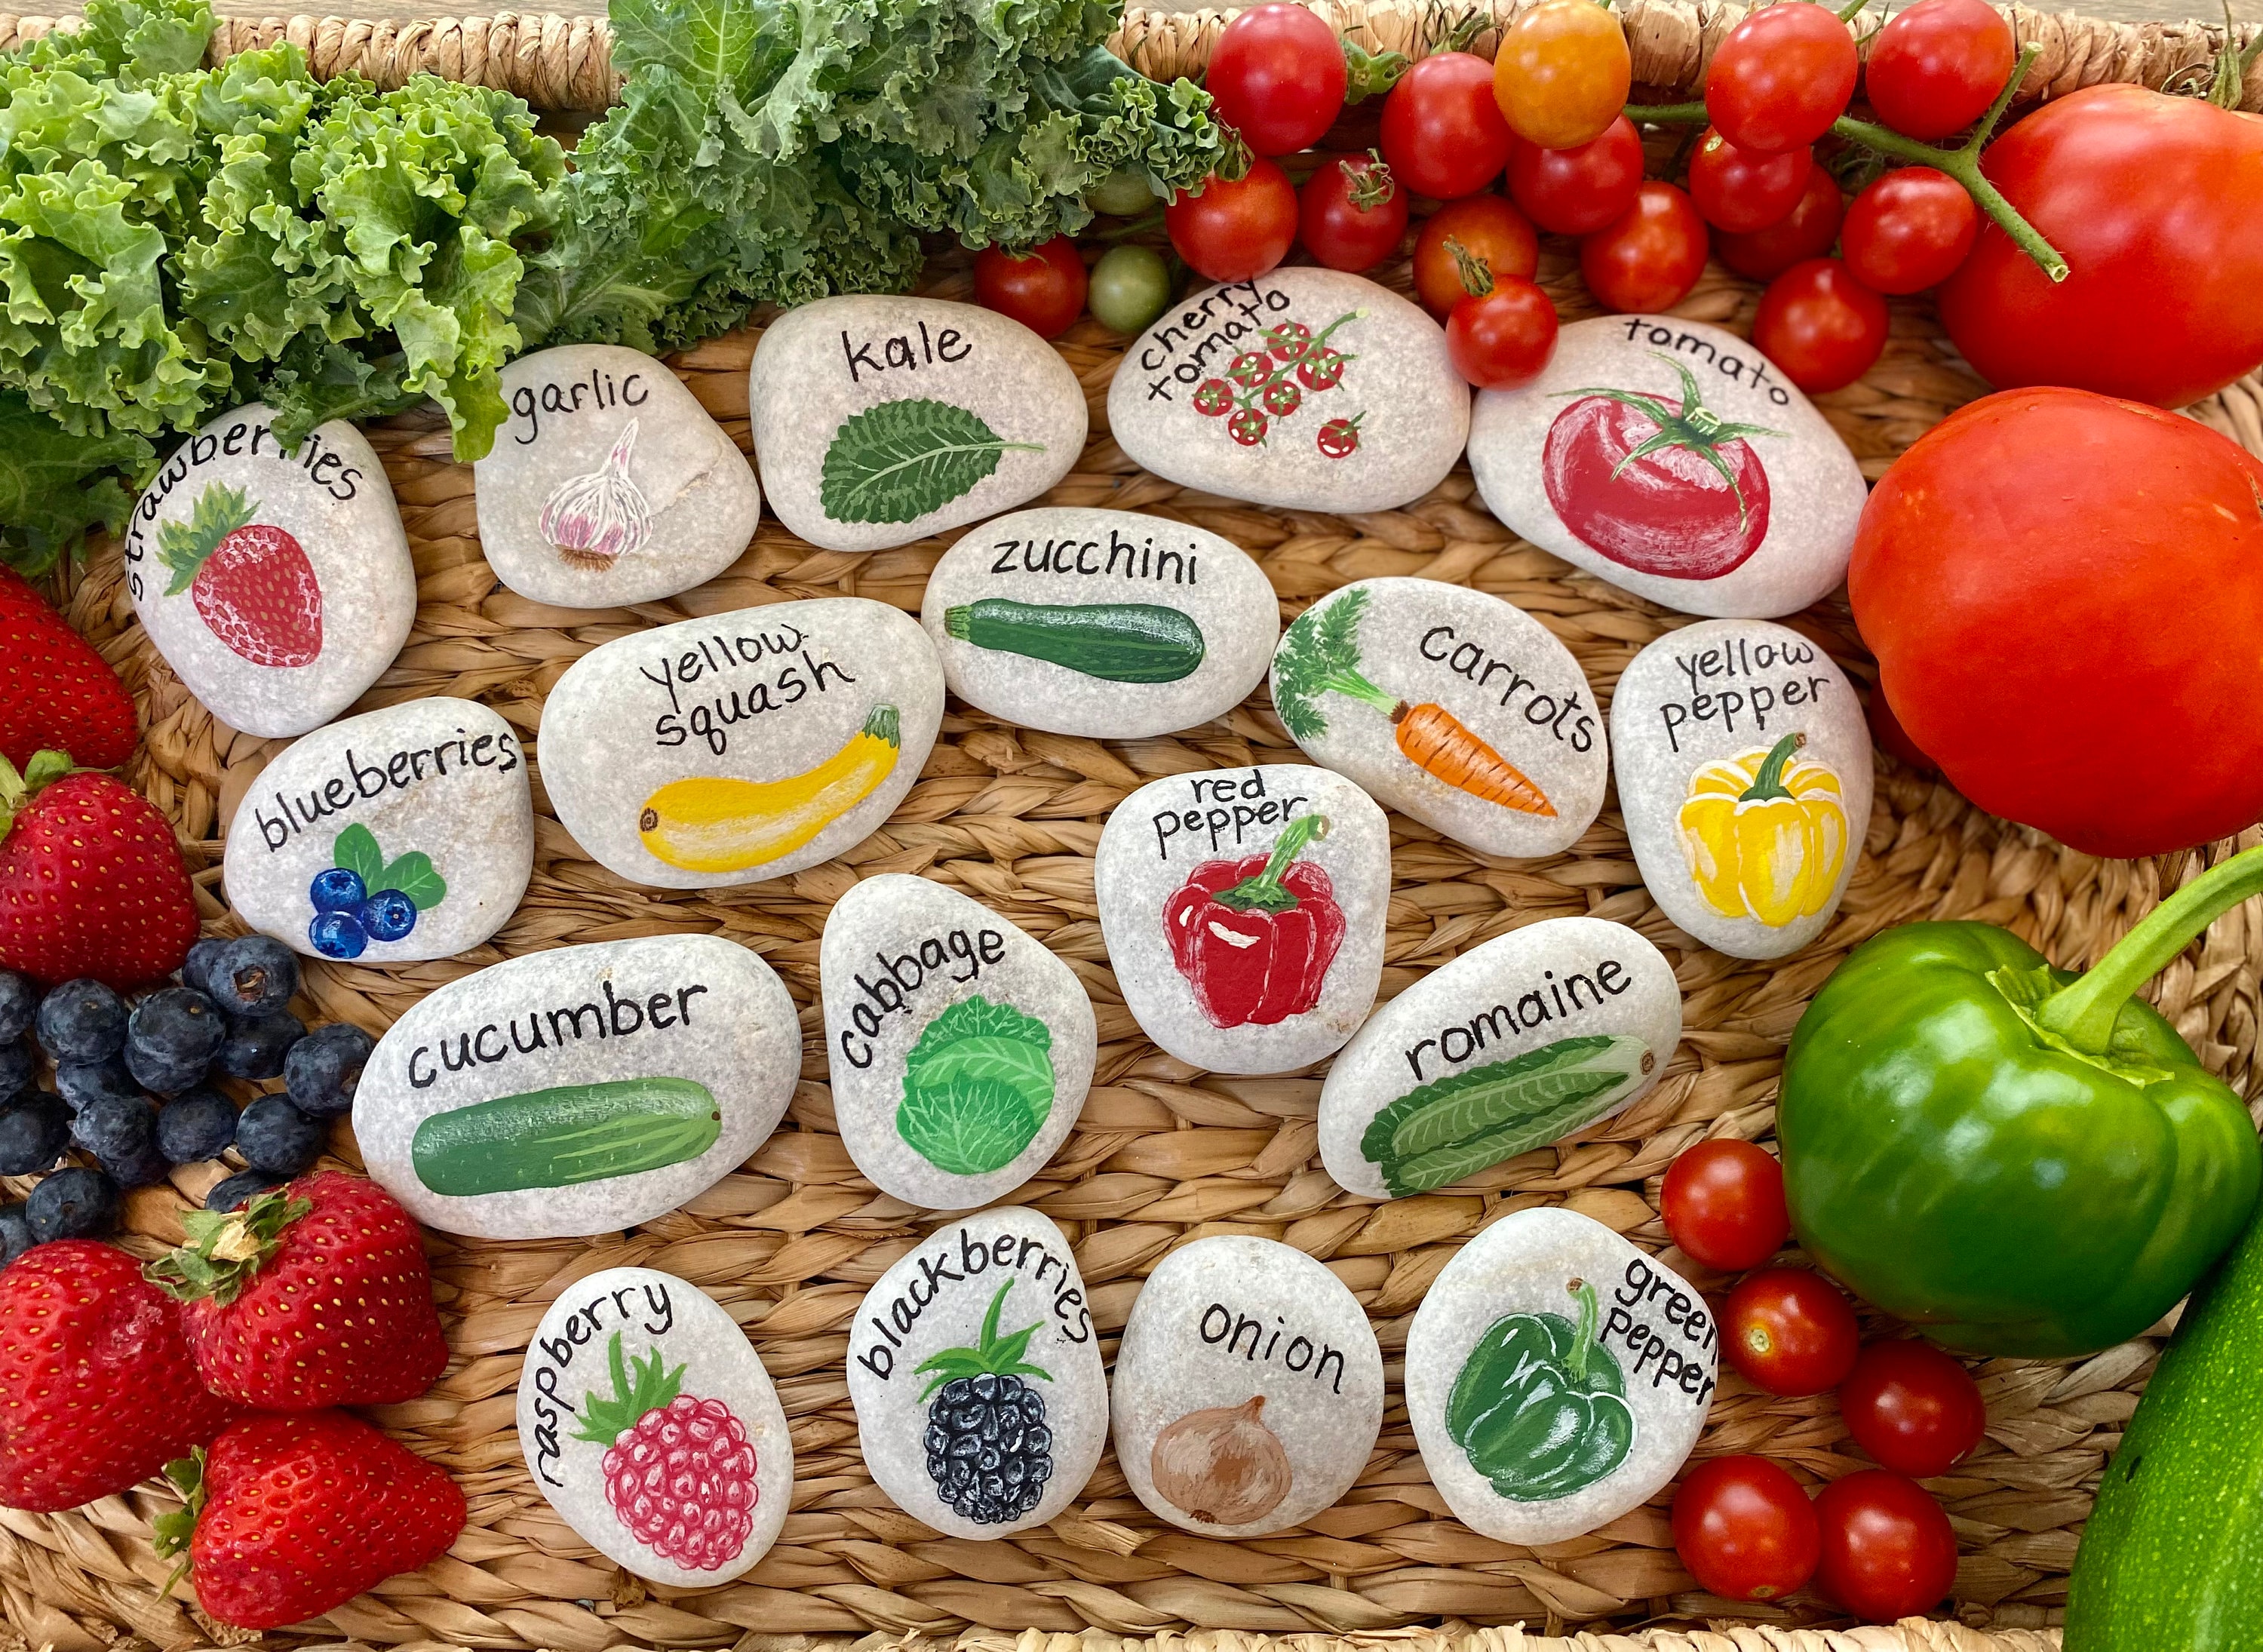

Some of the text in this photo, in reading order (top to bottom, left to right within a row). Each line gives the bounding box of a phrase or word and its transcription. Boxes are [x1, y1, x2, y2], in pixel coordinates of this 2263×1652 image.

[840, 321, 973, 382] kale
[1141, 280, 1262, 370] cherry
[1148, 290, 1290, 401] tomato
[1623, 317, 1791, 407] tomato
[512, 368, 650, 446] garlic
[125, 423, 363, 601] strawberies
[990, 530, 1199, 585] zucchini
[640, 624, 804, 714] yellow
[656, 650, 855, 755] squash
[1419, 625, 1595, 754] carrots
[1660, 677, 1831, 753] pepper
[1675, 638, 1813, 695] yellow
[255, 726, 518, 853] blueberries
[1153, 797, 1308, 860] pepper
[1190, 769, 1266, 803] red
[407, 979, 708, 1090] cucumber
[840, 927, 1006, 1070] cabbage
[1405, 958, 1633, 1082] romaine
[856, 1227, 1092, 1381] blackberries
[1200, 1302, 1345, 1396] onion
[1614, 1258, 1718, 1366] green
[537, 1282, 674, 1488] raspberry
[1600, 1307, 1715, 1405] pepper
